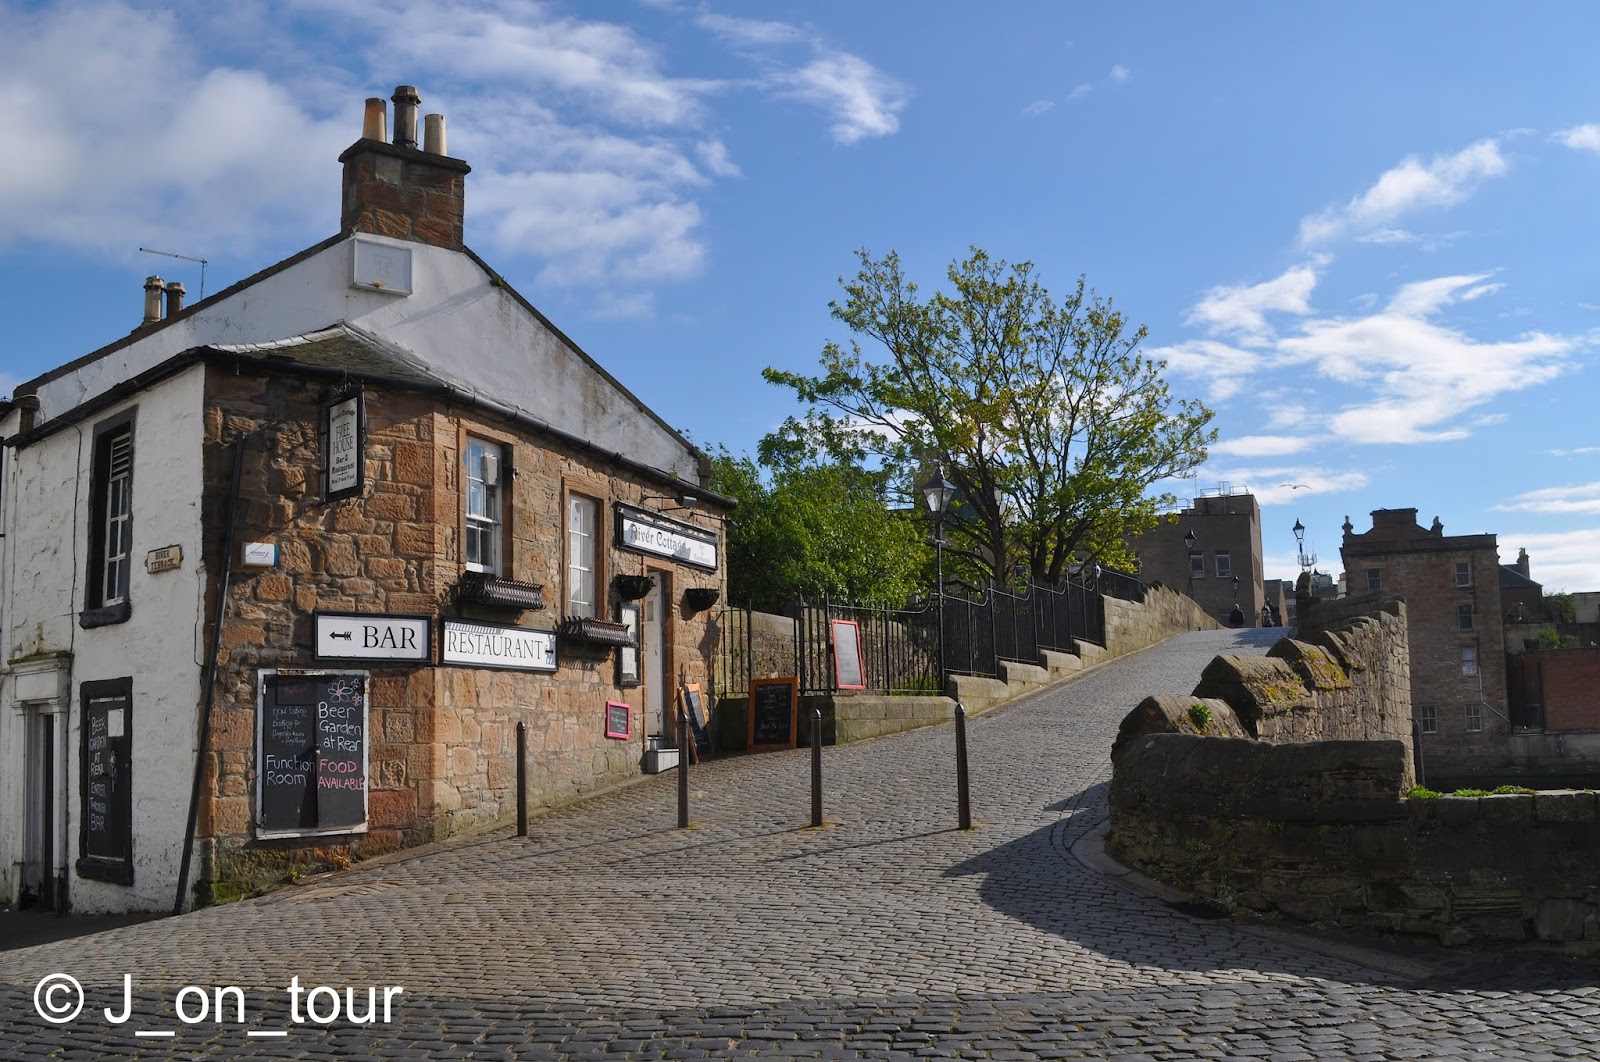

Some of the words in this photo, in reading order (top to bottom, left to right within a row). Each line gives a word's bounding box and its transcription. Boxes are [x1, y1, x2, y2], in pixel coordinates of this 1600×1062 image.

[335, 422, 351, 440] FREE
[333, 435, 353, 455] HOUSE
[332, 462, 355, 474] Restaurant
[155, 549, 170, 560] RIVER
[151, 558, 176, 570] TERRACE
[362, 625, 418, 650] BAR
[447, 630, 543, 660] RESTAURANT
[318, 701, 356, 719] Beer
[319, 720, 362, 736] Garden
[323, 736, 336, 748] at
[337, 737, 362, 751] Rear
[266, 755, 316, 773] Function
[319, 759, 358, 773] FOOD
[266, 771, 307, 787] Room
[317, 776, 366, 790] AVAILABLE
[90, 813, 105, 833] BAR
